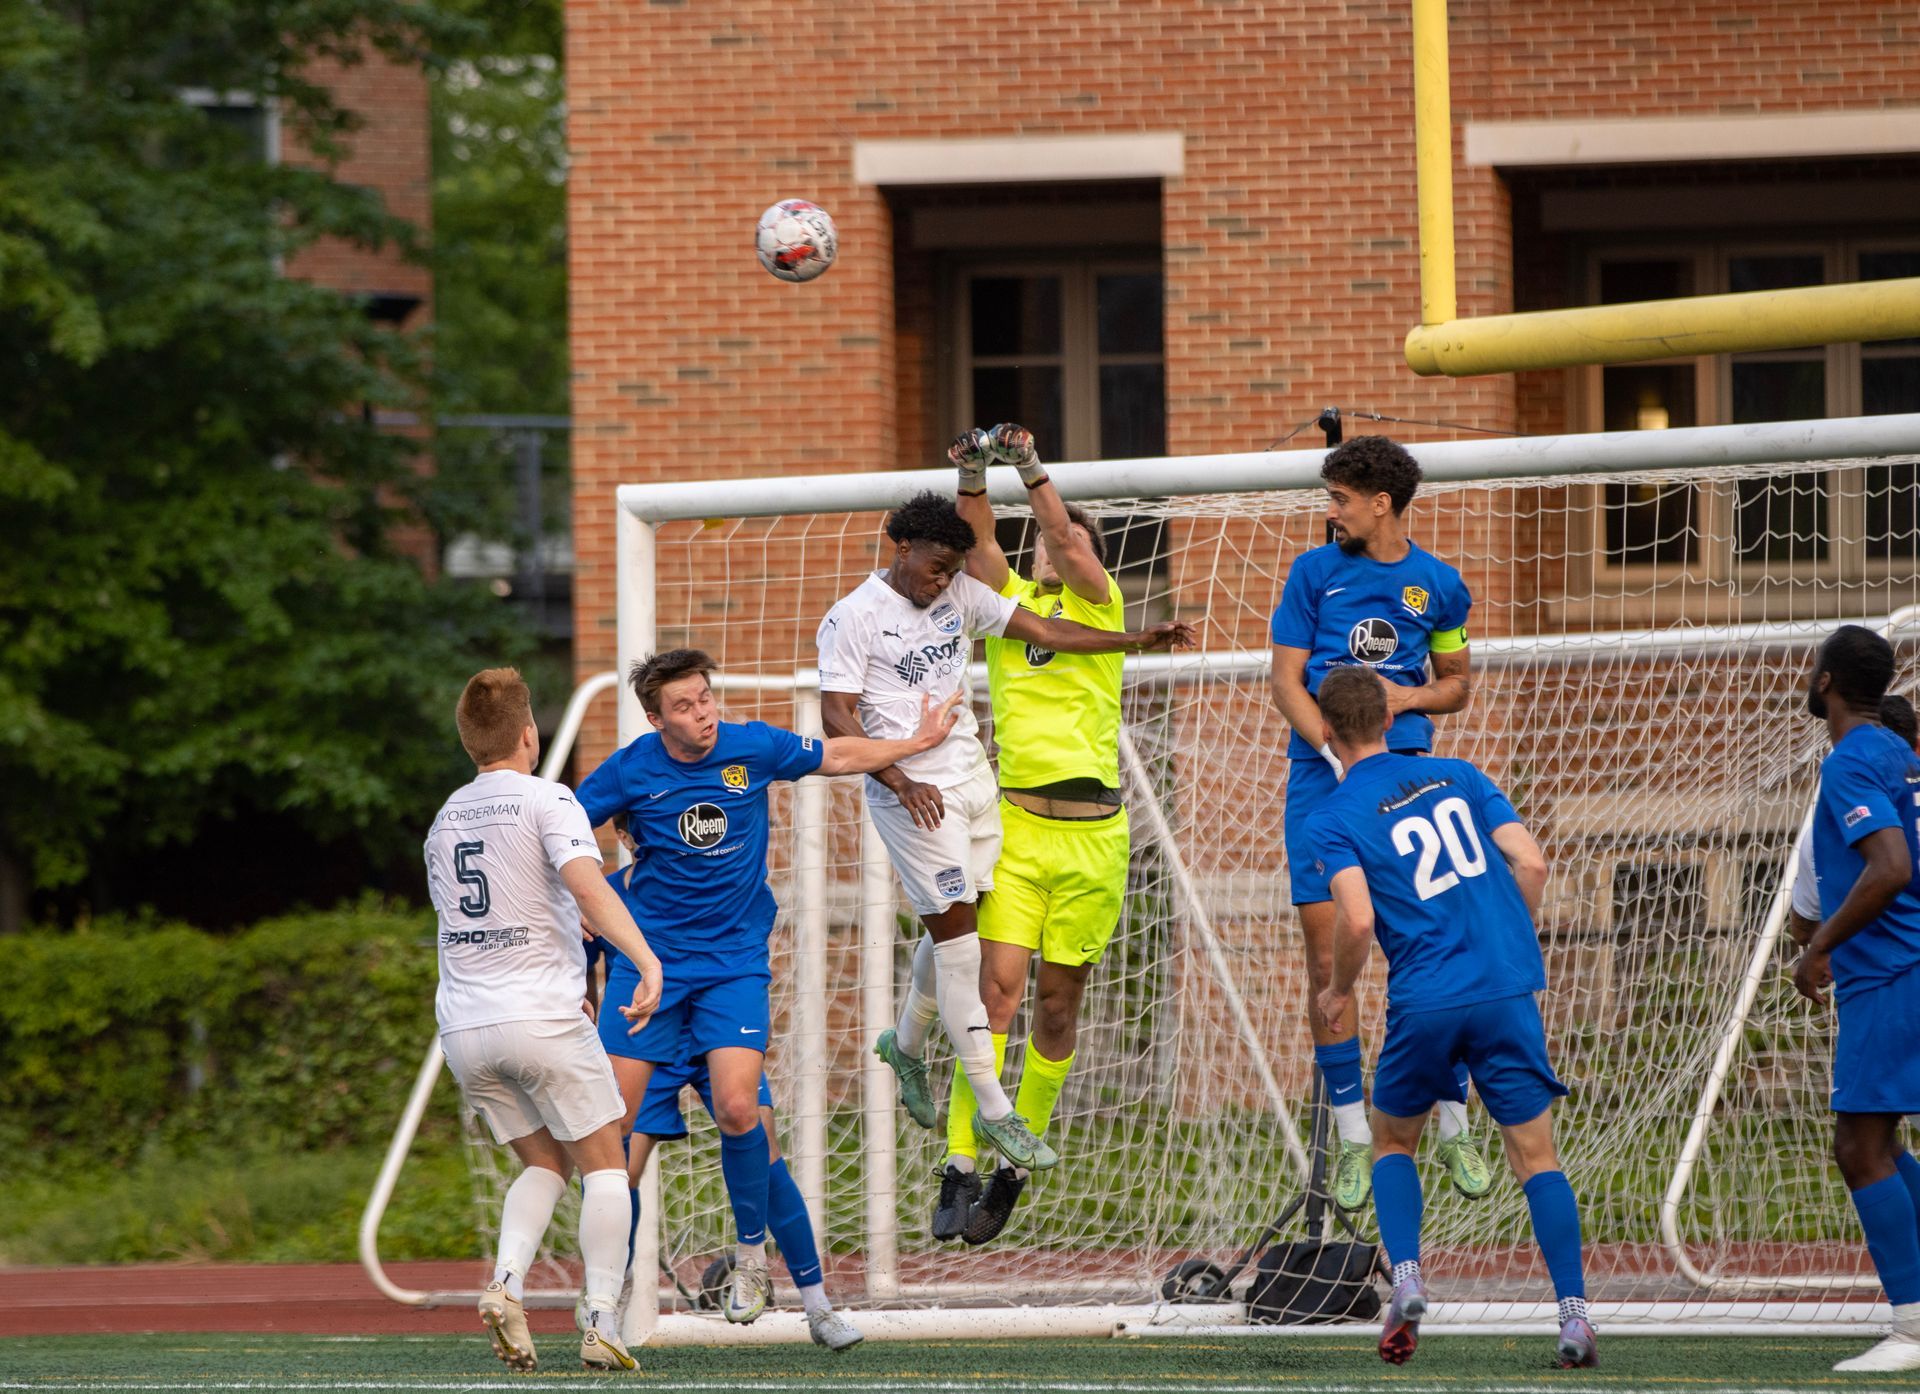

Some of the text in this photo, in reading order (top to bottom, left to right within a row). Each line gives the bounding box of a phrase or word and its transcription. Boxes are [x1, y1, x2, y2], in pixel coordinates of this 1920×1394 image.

[1354, 621, 1396, 656] Rheem
[440, 804, 520, 822] VORDERMAN
[684, 806, 726, 842] Rheem
[1391, 797, 1487, 901] 20
[454, 840, 490, 918] 5
[503, 938, 530, 949] UNION
